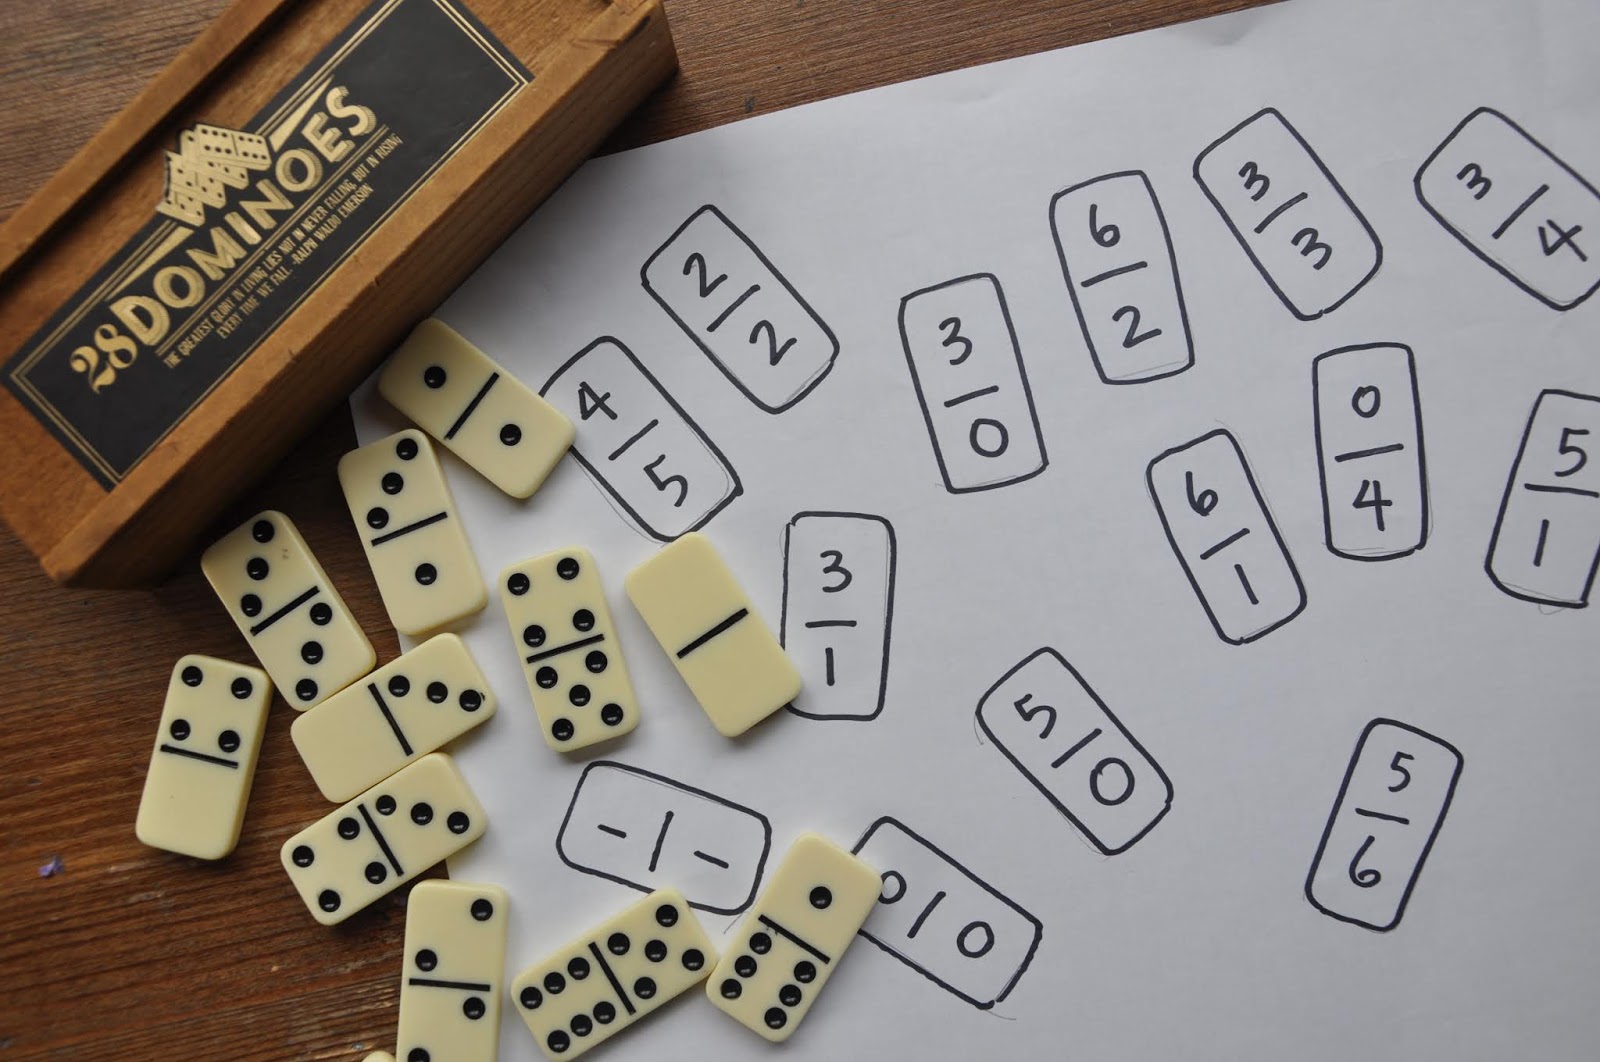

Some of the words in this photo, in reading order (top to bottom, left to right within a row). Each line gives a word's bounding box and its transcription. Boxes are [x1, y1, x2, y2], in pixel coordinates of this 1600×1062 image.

[1239, 162, 1270, 201] 3
[1457, 163, 1492, 200] 3
[1089, 204, 1120, 247] 6
[1538, 219, 1587, 262] 4
[163, 351, 181, 368] THE
[177, 318, 215, 356] GREATEST
[210, 298, 236, 323] GLORY
[231, 289, 245, 301] IN
[240, 266, 269, 293] LIVING
[262, 250, 283, 271] LIES
[277, 236, 297, 255] NOT
[291, 227, 306, 242] IN
[300, 205, 329, 232] NEVER
[351, 163, 370, 183] BUT
[365, 154, 380, 168] IN
[374, 132, 404, 160] RISING
[216, 313, 243, 339] EVERY
[239, 295, 259, 315] TIME
[256, 281, 273, 297] WE
[269, 265, 293, 286] FALL.
[291, 237, 319, 265] -RALPH
[313, 213, 342, 241] WALDO
[336, 182, 374, 219] EMERSON
[1291, 228, 1332, 270] 3
[683, 253, 728, 298] 2
[749, 320, 797, 366] 2
[939, 317, 972, 365] 3
[1112, 306, 1162, 348] 2
[578, 381, 618, 420] 4
[1352, 385, 1380, 418] 0
[970, 418, 1009, 458] 0
[1555, 428, 1590, 477] 5
[643, 454, 688, 507] 5
[1185, 471, 1218, 516] 6
[1352, 480, 1392, 531] 4
[1533, 519, 1549, 567] 1
[820, 550, 852, 593] 3
[1234, 564, 1259, 605] 1
[825, 647, 835, 686] 1
[1014, 694, 1057, 739] 5
[1090, 757, 1135, 806] 0
[1388, 751, 1414, 792] 5
[1349, 835, 1381, 888] 6
[957, 921, 994, 958] 0
